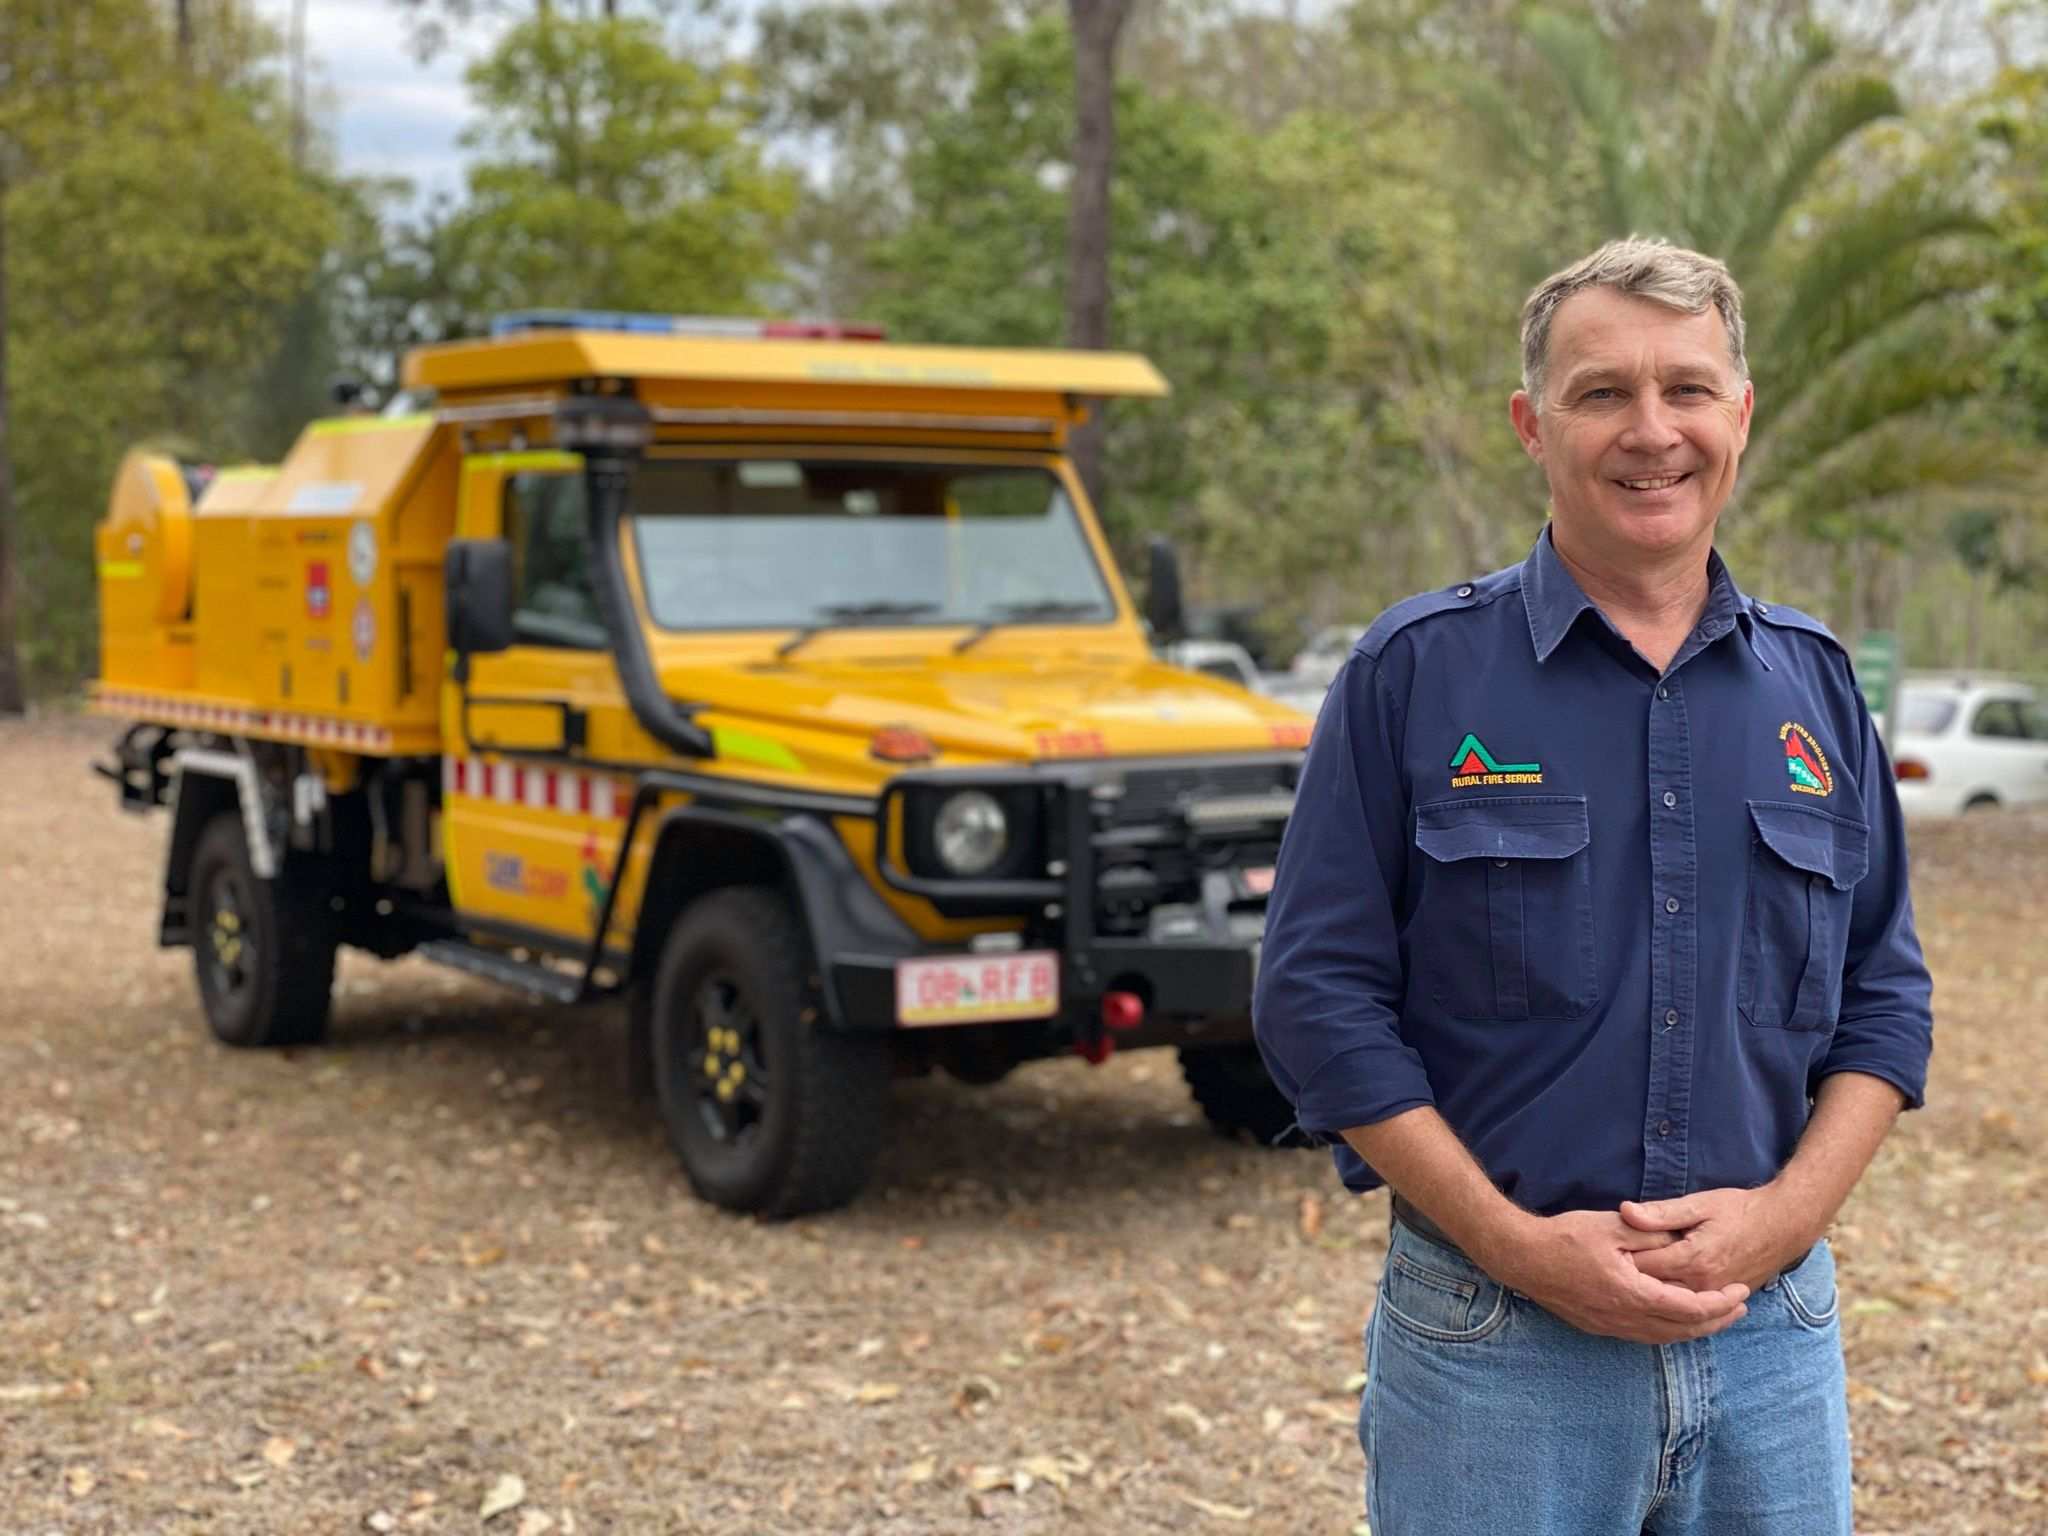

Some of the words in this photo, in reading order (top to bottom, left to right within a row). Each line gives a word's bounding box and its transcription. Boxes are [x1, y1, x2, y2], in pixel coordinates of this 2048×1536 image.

[1452, 775, 1482, 788] RURAL
[1483, 774, 1504, 785] FIRE
[1504, 773, 1543, 784] SERVICE
